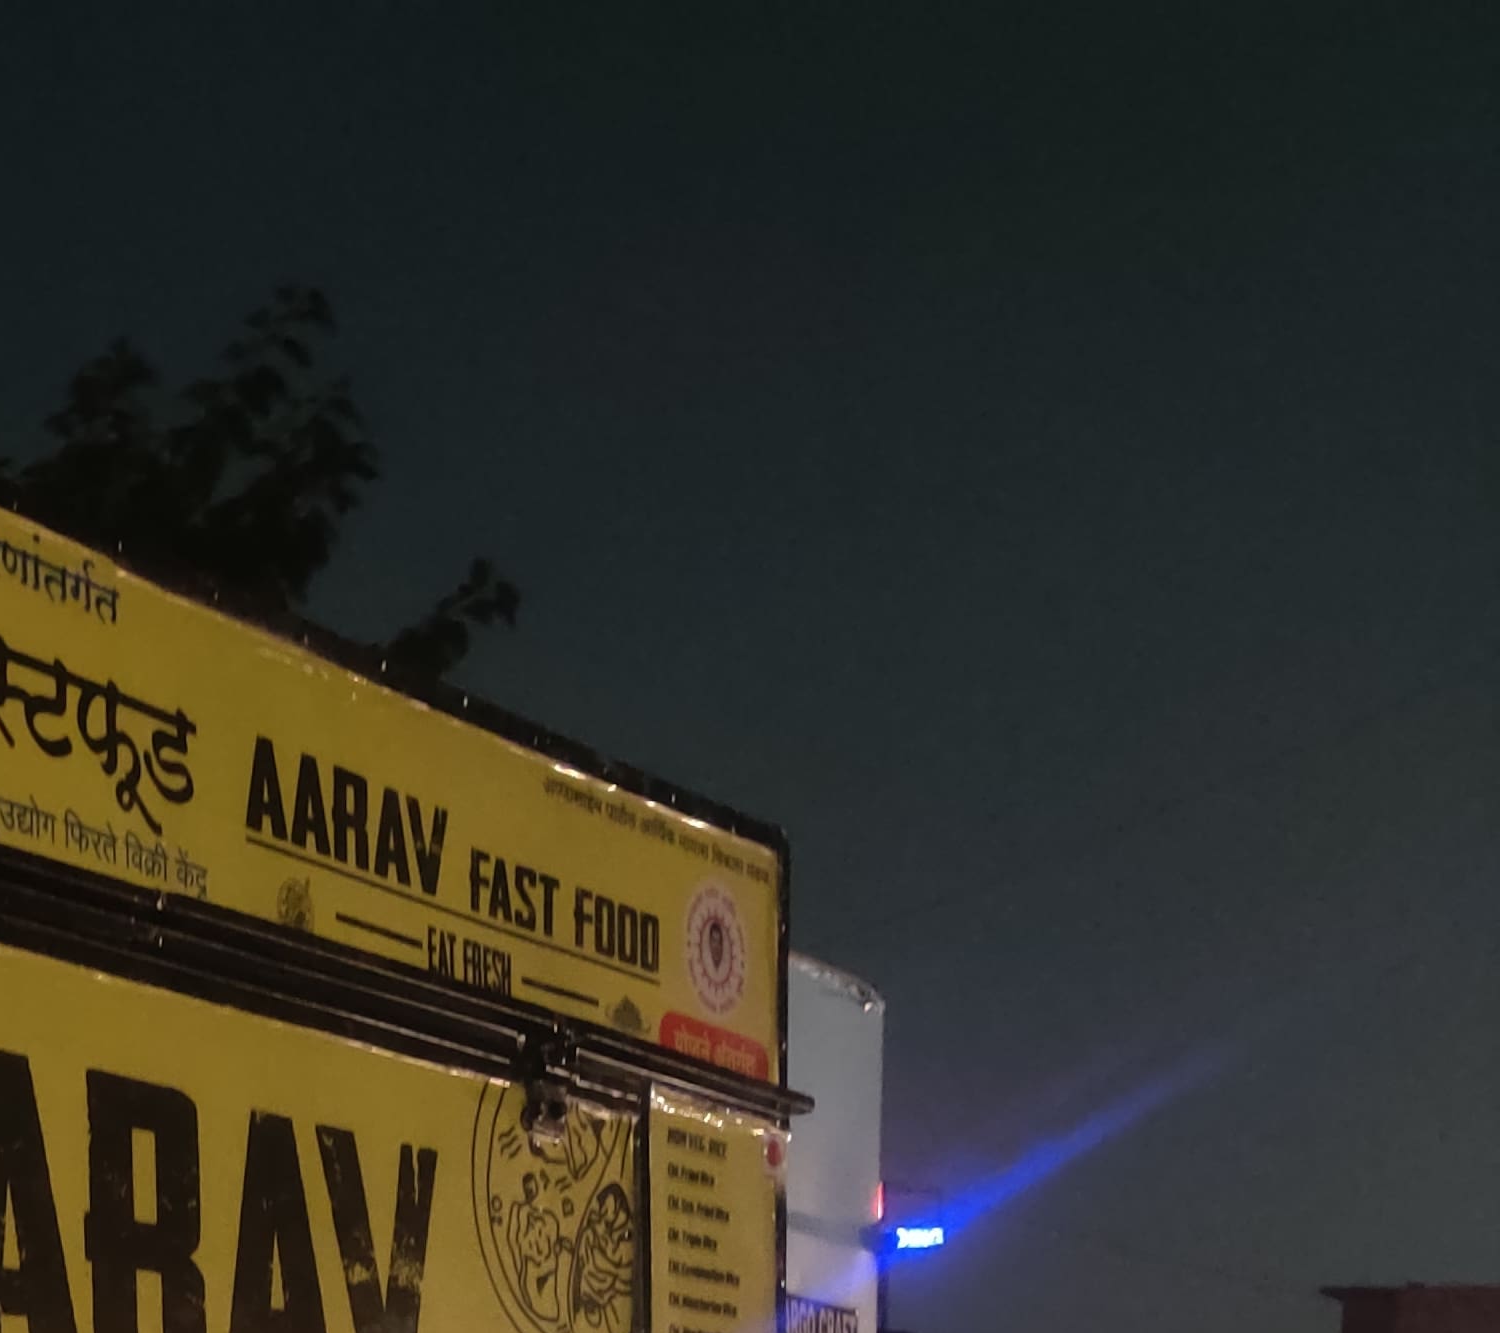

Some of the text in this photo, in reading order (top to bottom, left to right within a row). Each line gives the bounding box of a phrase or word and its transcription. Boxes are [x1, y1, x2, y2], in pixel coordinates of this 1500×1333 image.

[246, 732, 447, 896] AARAV
[470, 846, 559, 937] FAST
[574, 886, 659, 973] FOOD
[427, 926, 512, 997] EAT FRESH
